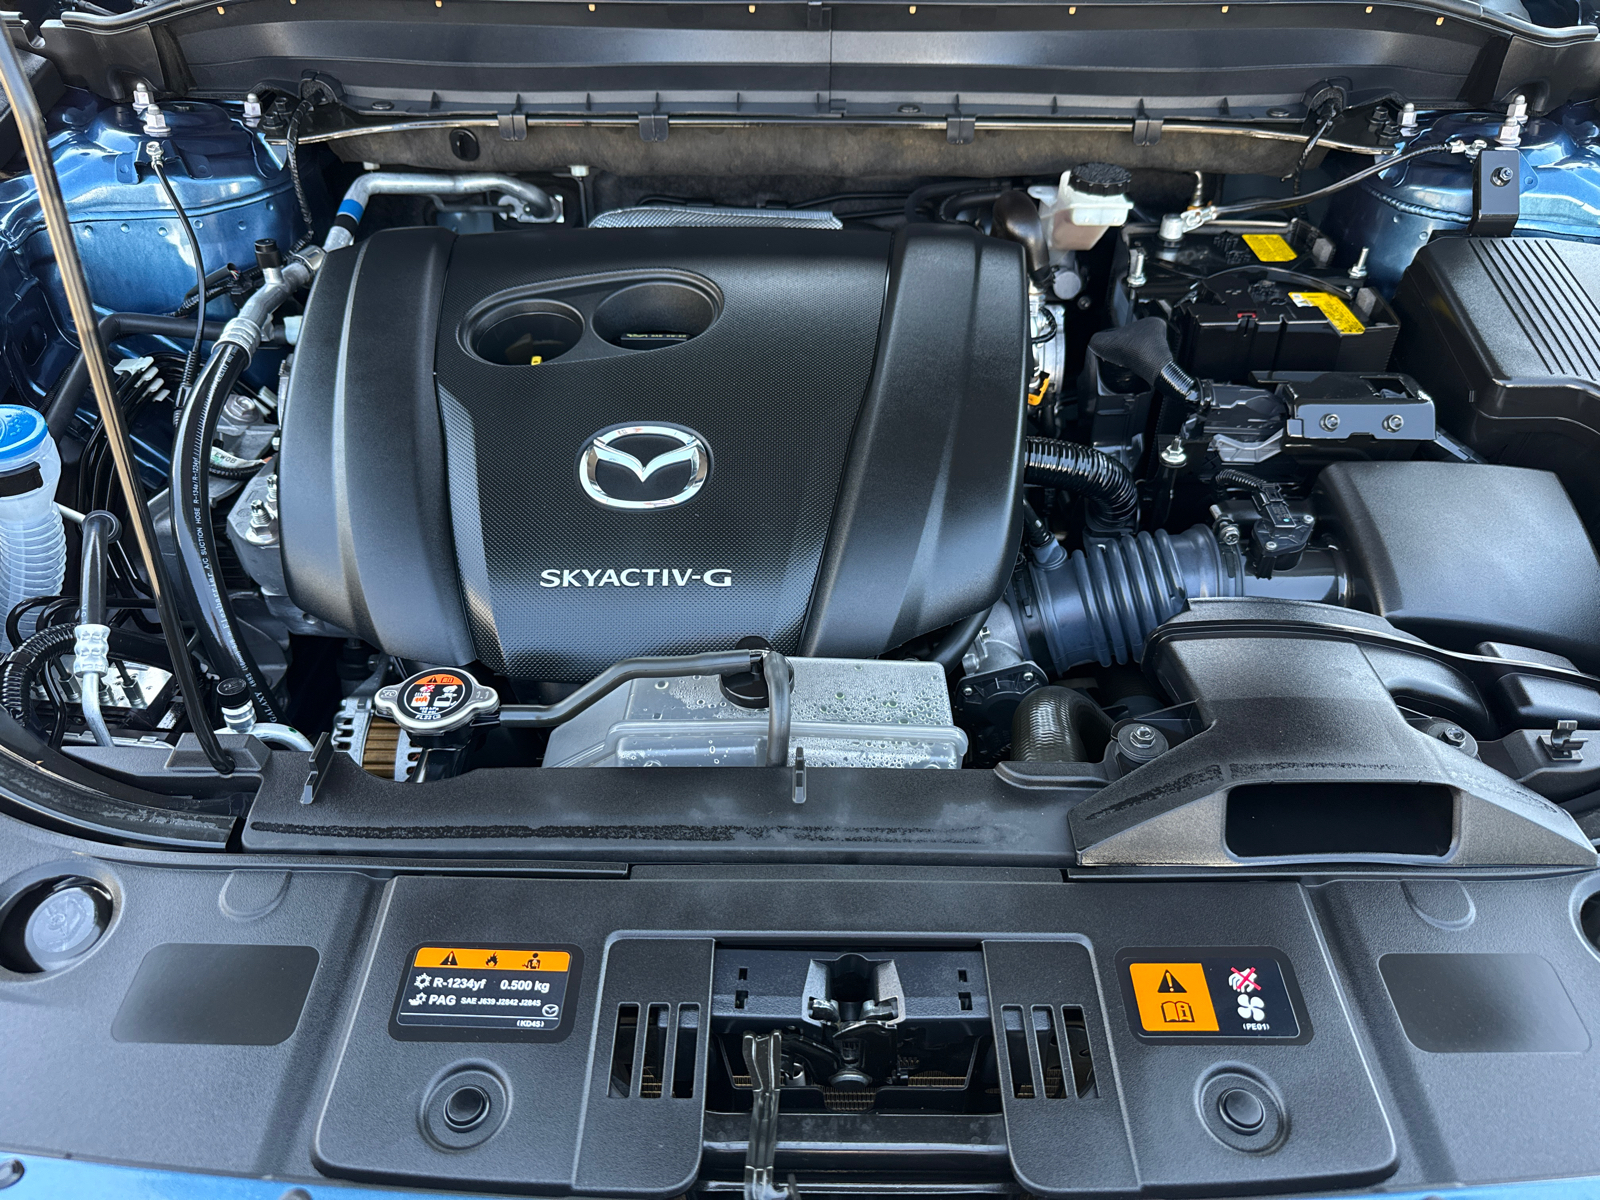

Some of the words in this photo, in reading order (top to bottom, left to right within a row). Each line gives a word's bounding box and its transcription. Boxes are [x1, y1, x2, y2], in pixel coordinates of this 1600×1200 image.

[193, 507, 202, 524] HOSE
[196, 527, 208, 556] SUCTION
[202, 558, 210, 569] A/C
[539, 568, 732, 588] SKYACTIV-G
[208, 573, 230, 629] Flexbarrier
[254, 691, 277, 723] GALAXY
[433, 977, 487, 991] R-1234yf
[500, 980, 533, 991] 0.500
[533, 981, 550, 993] kg
[428, 995, 456, 1006] PAG
[461, 997, 477, 1005] SAE
[496, 998, 519, 1006] J2842
[519, 999, 541, 1007] J2845
[517, 1020, 544, 1028] (KD45)
[1243, 1023, 1270, 1031] (PE01)
